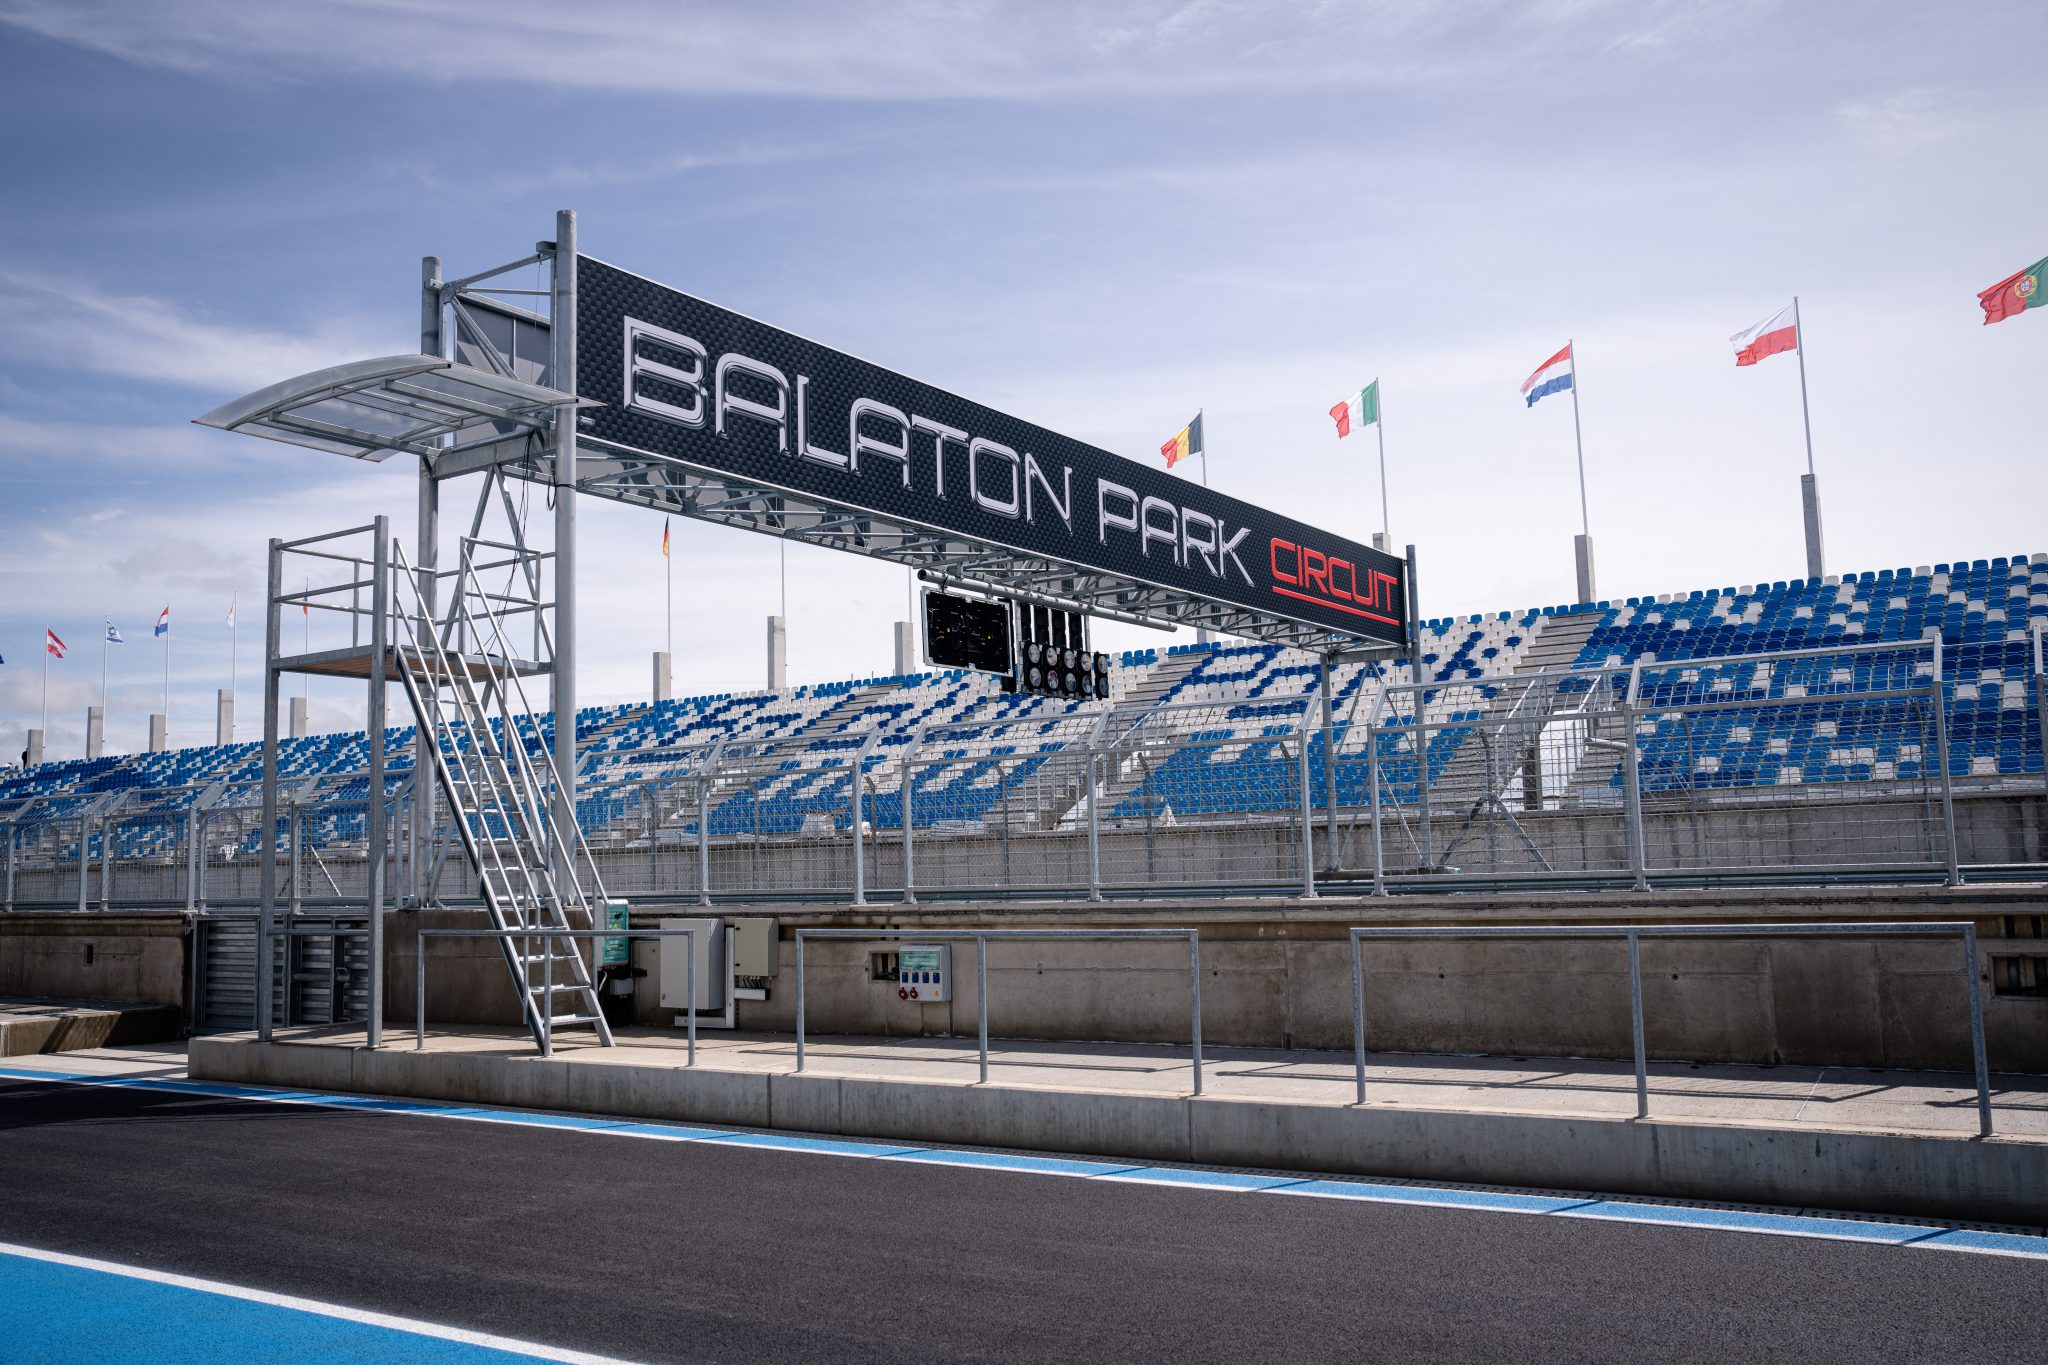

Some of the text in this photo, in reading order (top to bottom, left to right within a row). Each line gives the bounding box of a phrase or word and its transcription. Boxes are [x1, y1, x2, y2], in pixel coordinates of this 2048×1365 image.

[623, 315, 1400, 612] BALATON PARK CIRCUIT
